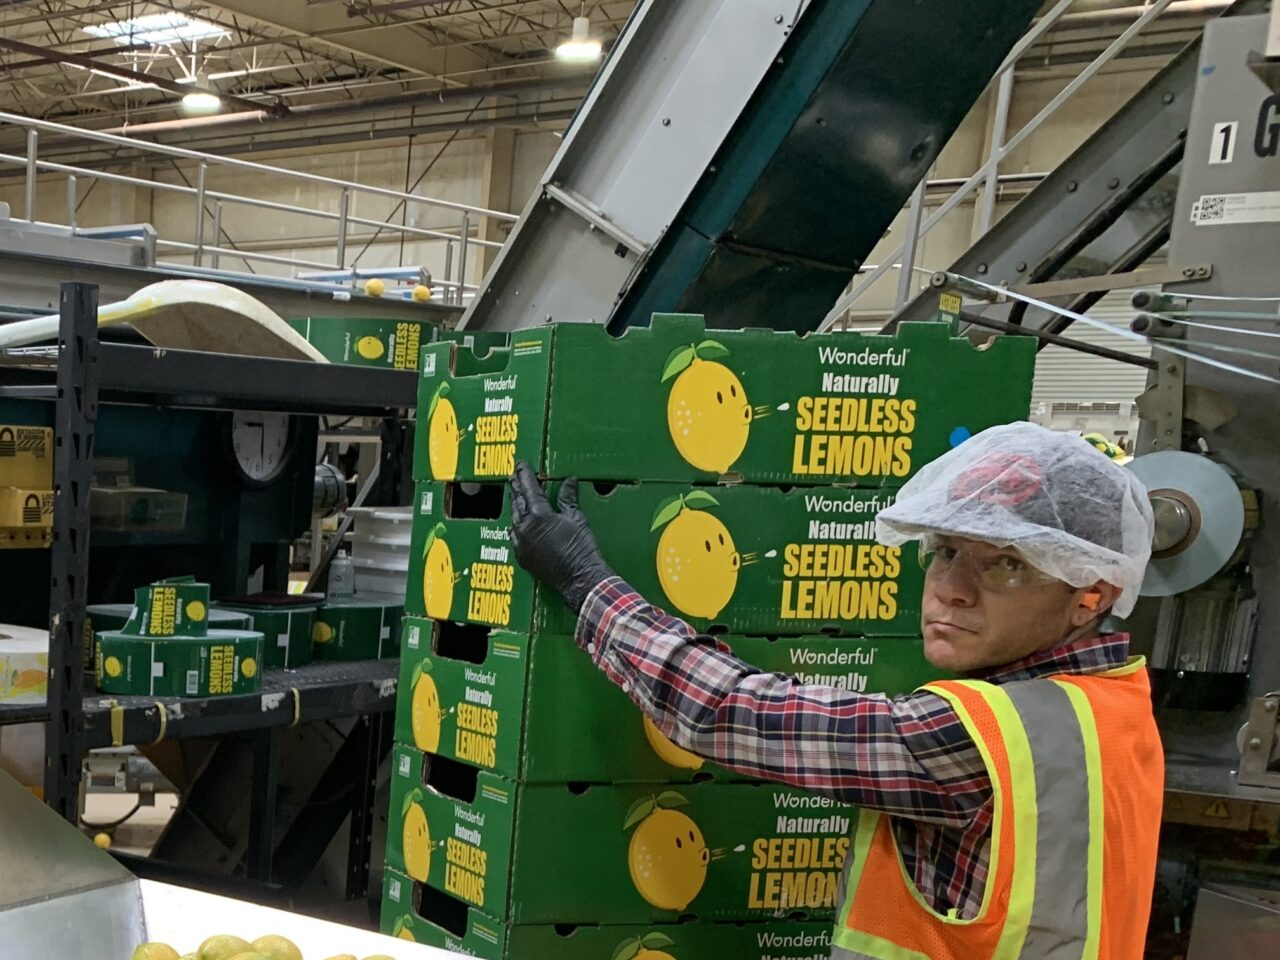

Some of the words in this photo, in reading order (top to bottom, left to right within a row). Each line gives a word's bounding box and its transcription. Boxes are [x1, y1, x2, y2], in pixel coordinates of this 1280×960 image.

[1220, 124, 1232, 160] 1
[394, 322, 409, 370] EEDLESS
[406, 323, 421, 370] EMONS
[818, 346, 907, 367] Wonderful
[484, 375, 518, 392] Wonderful
[822, 372, 900, 396] Naturally
[484, 395, 513, 413] Naturally
[795, 396, 917, 434] SEEDLESS
[475, 414, 518, 443] SEEDLESS
[474, 444, 516, 476] LEMONS
[792, 434, 913, 477] LEMONS
[808, 520, 877, 540] Naturall
[480, 545, 509, 564] Naturally
[783, 543, 901, 578] SEEDLESS
[470, 562, 514, 593] SEEDLESS
[150, 587, 165, 635] LEMONS
[162, 587, 177, 635] SEEDLESS
[467, 590, 511, 626] LEMONS
[780, 580, 898, 620] LEMONS
[209, 645, 224, 693] LEMONS
[222, 645, 235, 693] SEEDLESS
[790, 647, 875, 665] Wonderful
[464, 667, 496, 686] Wonderful
[464, 686, 493, 707] Naturally
[456, 702, 498, 736] SEEDLESS
[455, 729, 496, 768] LEMONS
[454, 804, 484, 826] Wonderful
[776, 815, 850, 835] Naturally
[454, 823, 481, 846] Naturally
[446, 837, 487, 876] SEEDLESS
[751, 837, 850, 870] SEEDLES
[444, 863, 485, 907] LEMONS
[748, 871, 842, 909] LEMON
[757, 930, 833, 948] Wonderfu
